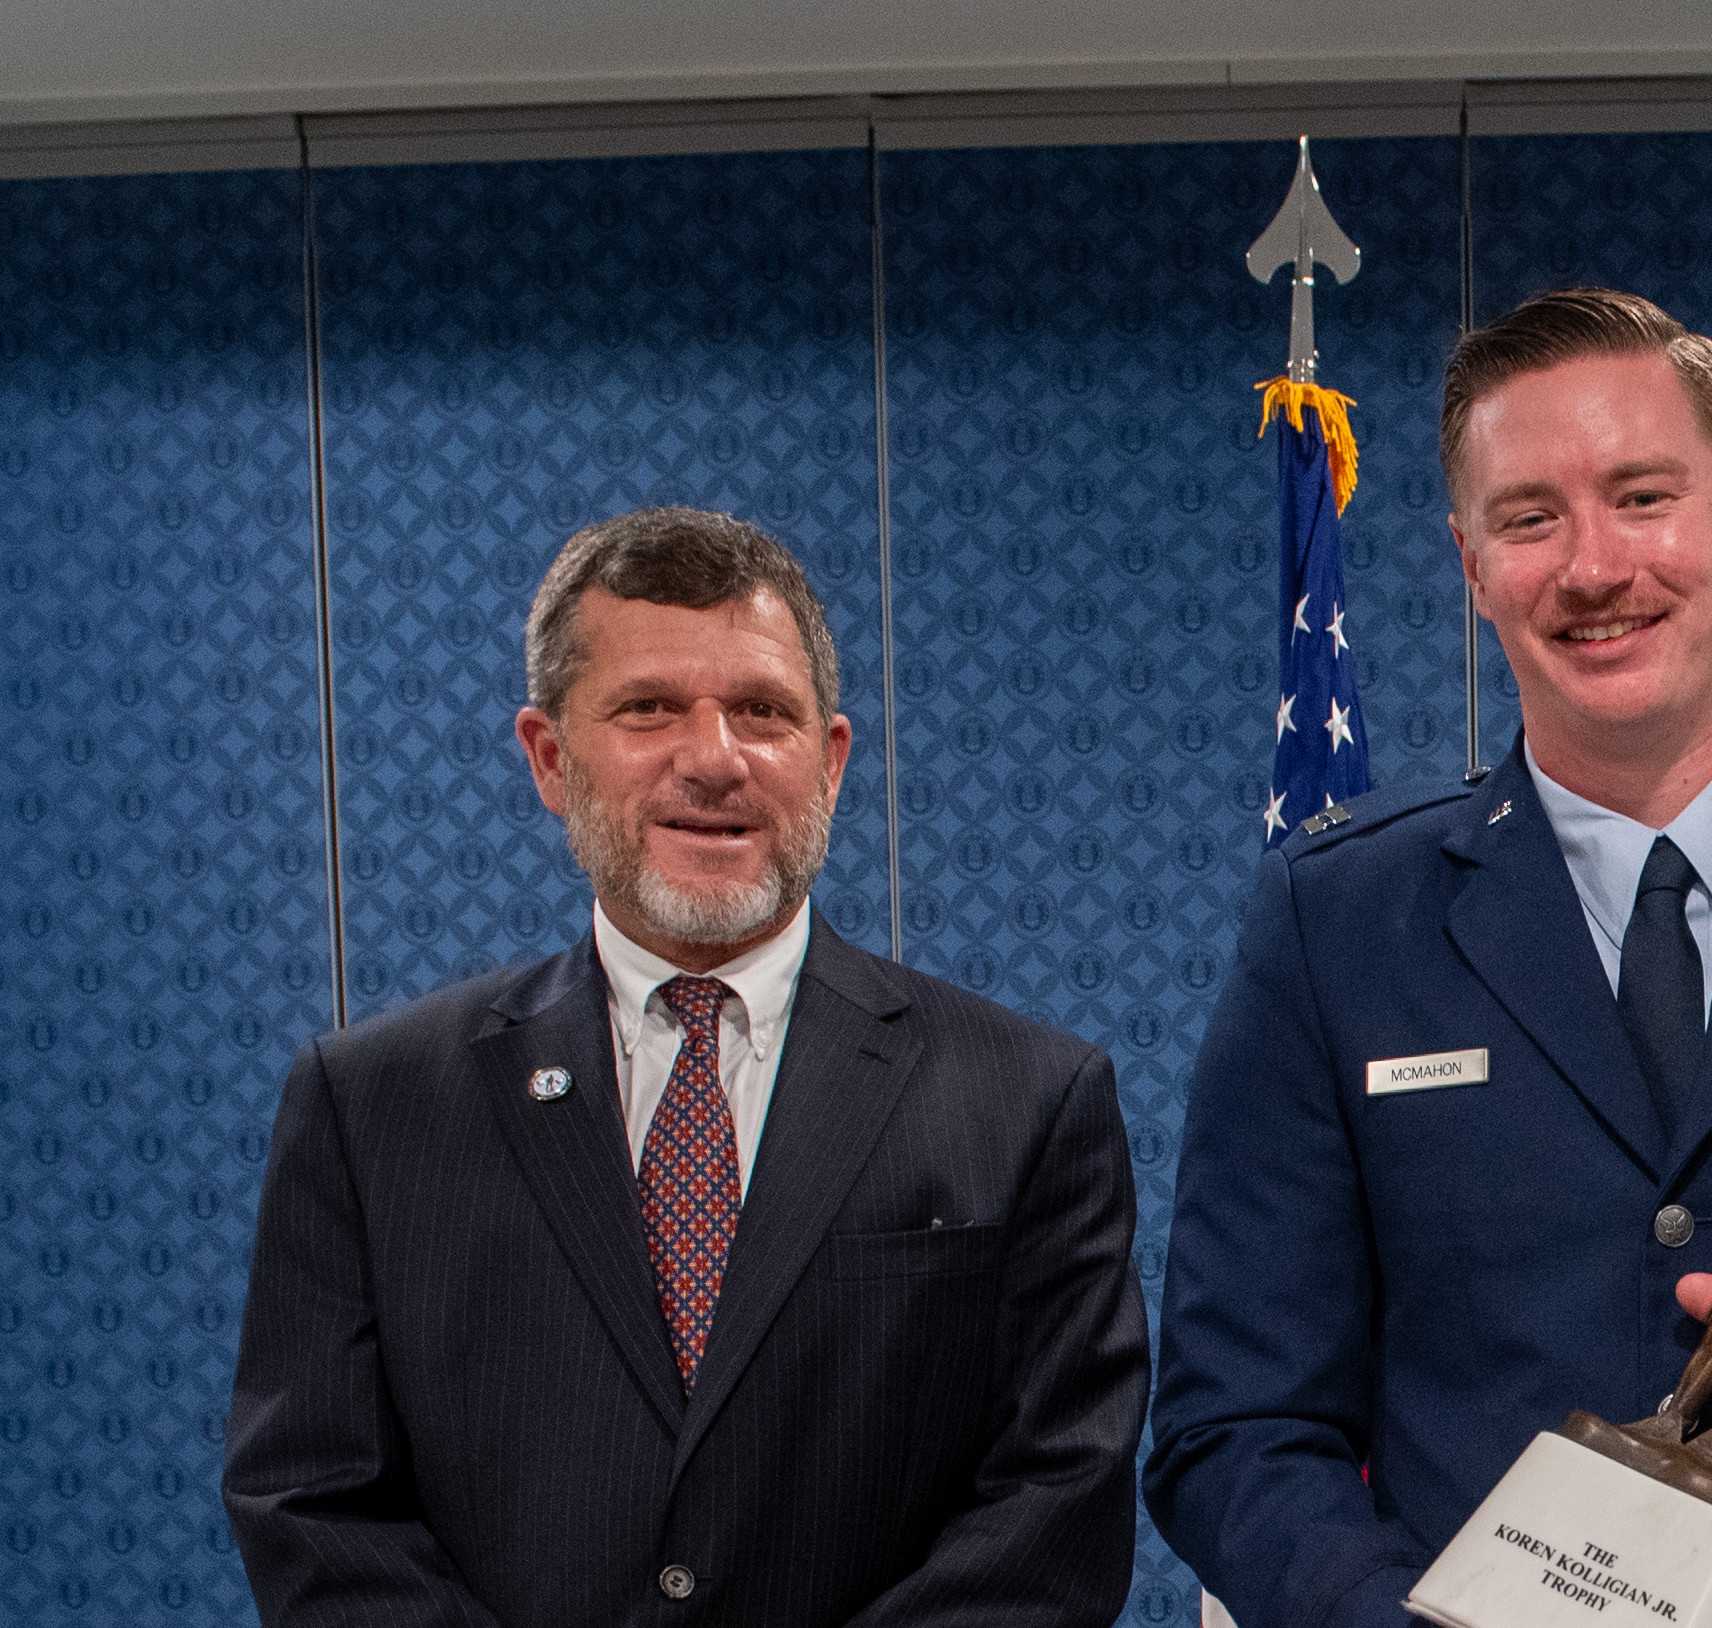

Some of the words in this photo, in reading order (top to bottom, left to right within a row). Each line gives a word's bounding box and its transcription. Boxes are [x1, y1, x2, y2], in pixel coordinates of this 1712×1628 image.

[1390, 1061, 1462, 1083] MCMAHON
[1494, 1523, 1557, 1562] KOREN
[1555, 1553, 1653, 1608] KOLLIGIAN
[1651, 1599, 1677, 1623] JR.
[1582, 1541, 1619, 1569] THE
[1540, 1568, 1612, 1613] TROPHY
